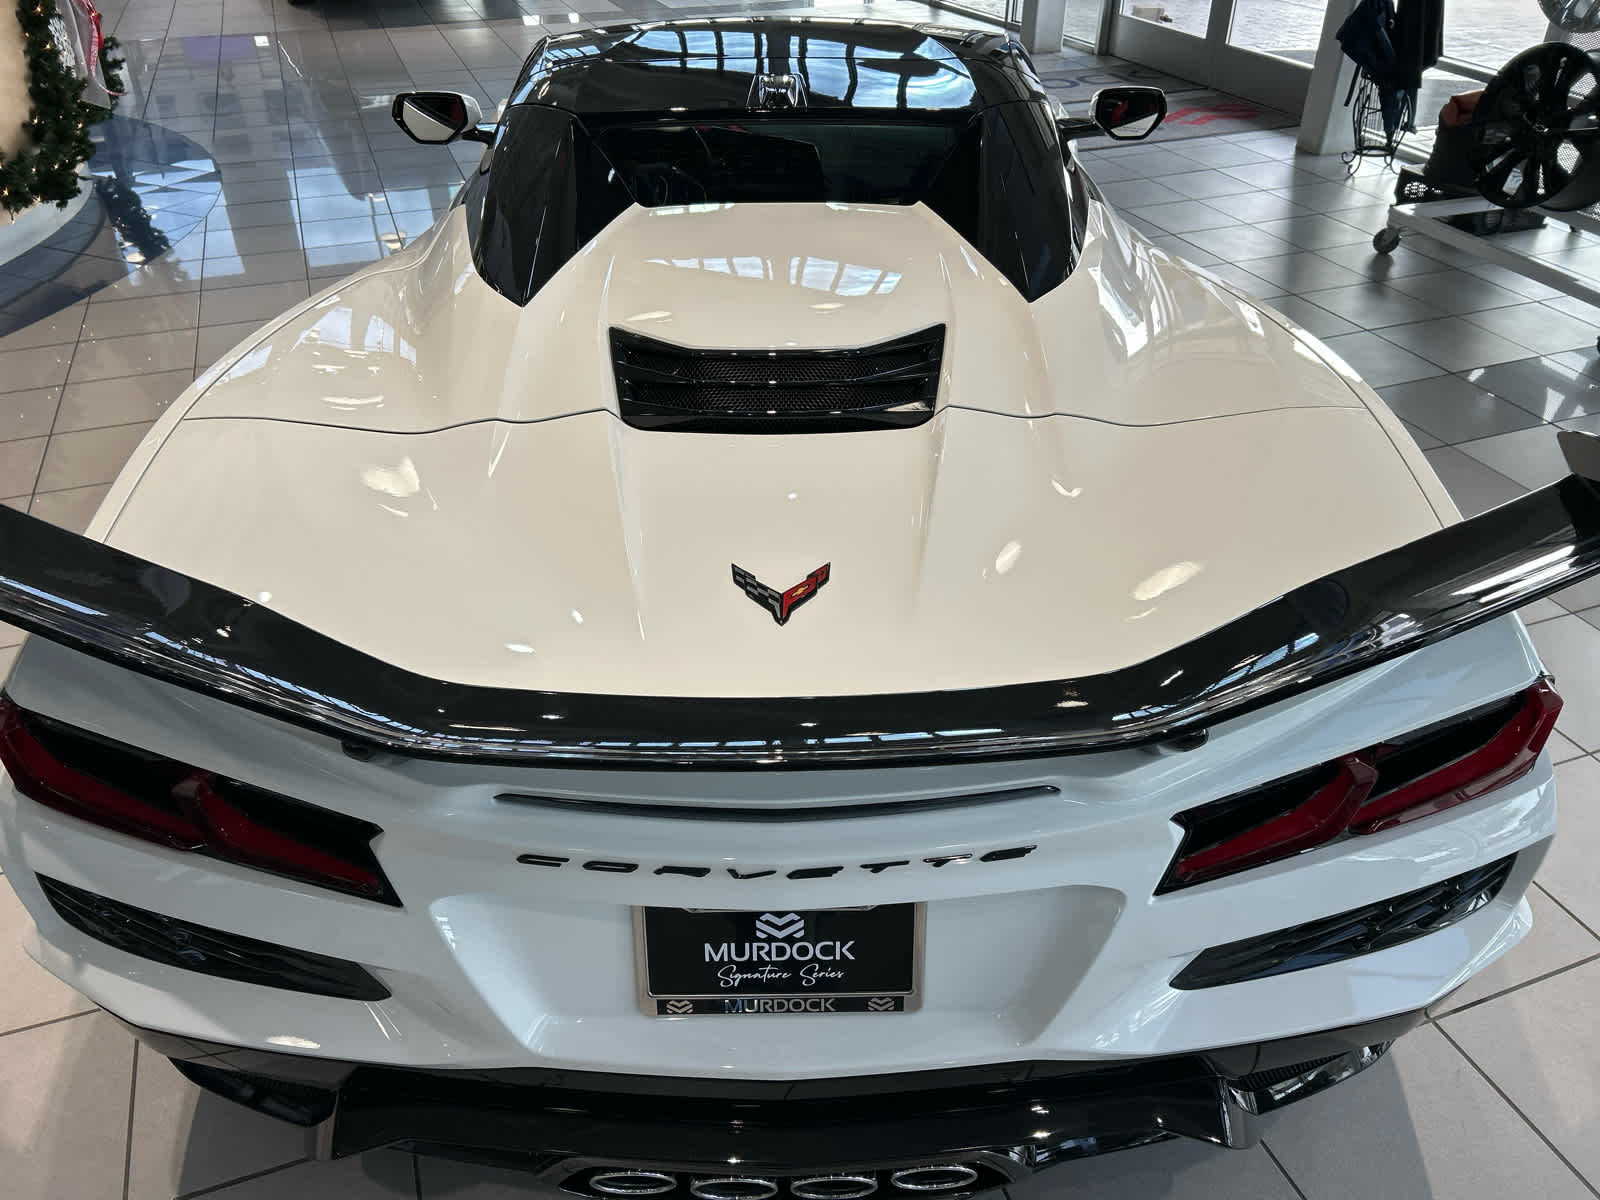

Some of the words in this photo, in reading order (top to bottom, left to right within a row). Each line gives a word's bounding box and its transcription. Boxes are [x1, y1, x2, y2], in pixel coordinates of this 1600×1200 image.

[516, 845, 1038, 880] CORVETTE
[704, 940, 856, 962] MURDOCK
[716, 963, 793, 988] Signature
[799, 963, 845, 987] Series
[724, 998, 836, 1014] MURDOCK
